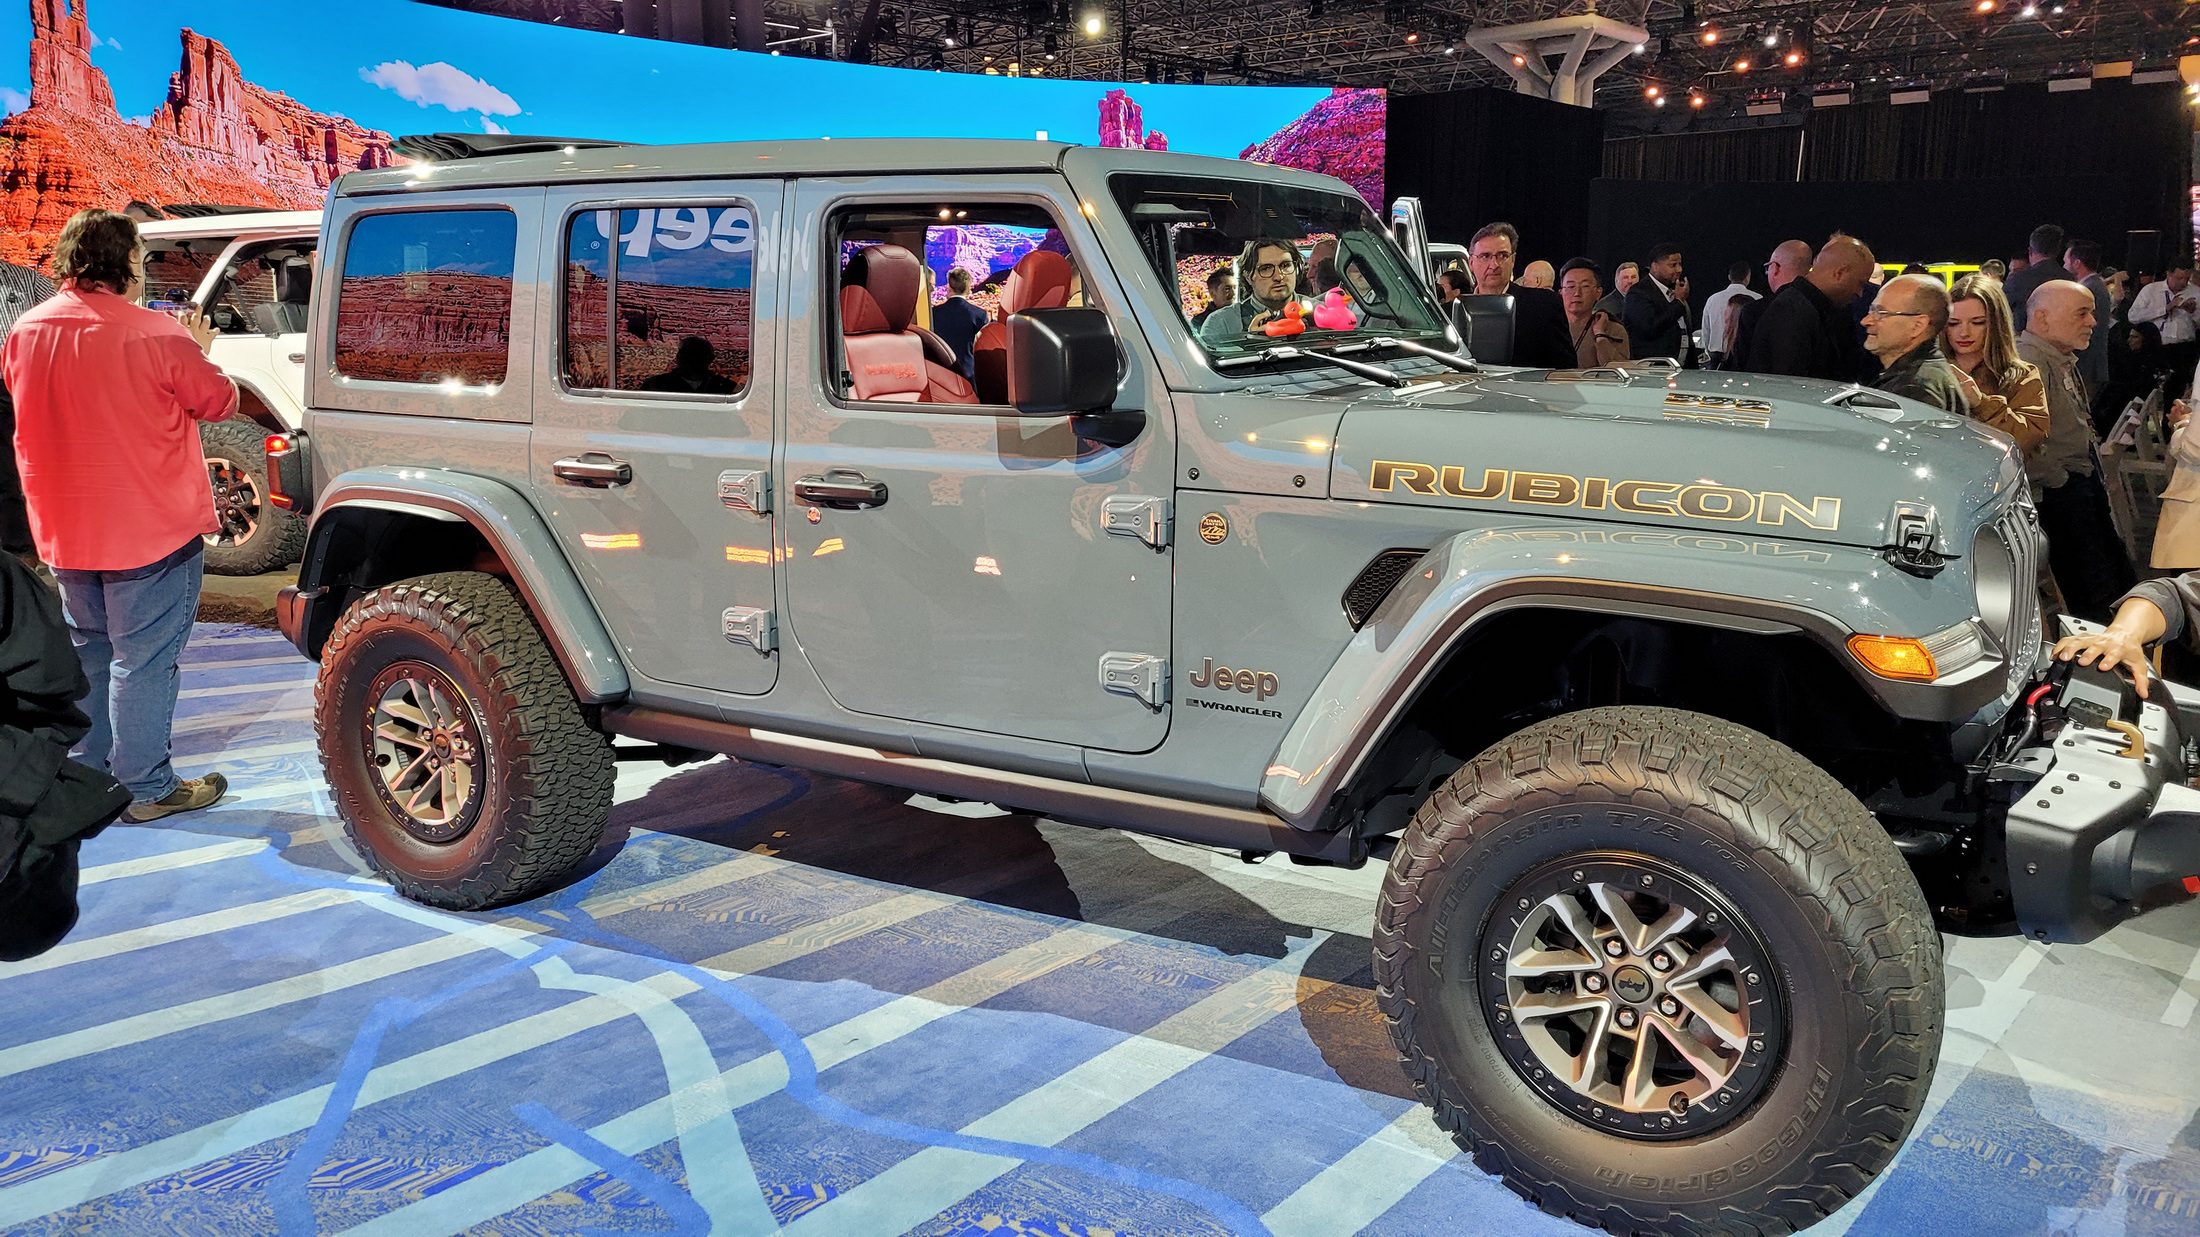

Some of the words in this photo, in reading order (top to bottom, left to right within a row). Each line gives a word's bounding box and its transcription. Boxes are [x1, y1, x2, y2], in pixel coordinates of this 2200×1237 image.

[1369, 459, 1842, 531] RUBICON
[1189, 656, 1279, 702] Jeep
[1199, 699, 1283, 719] WRANGLER
